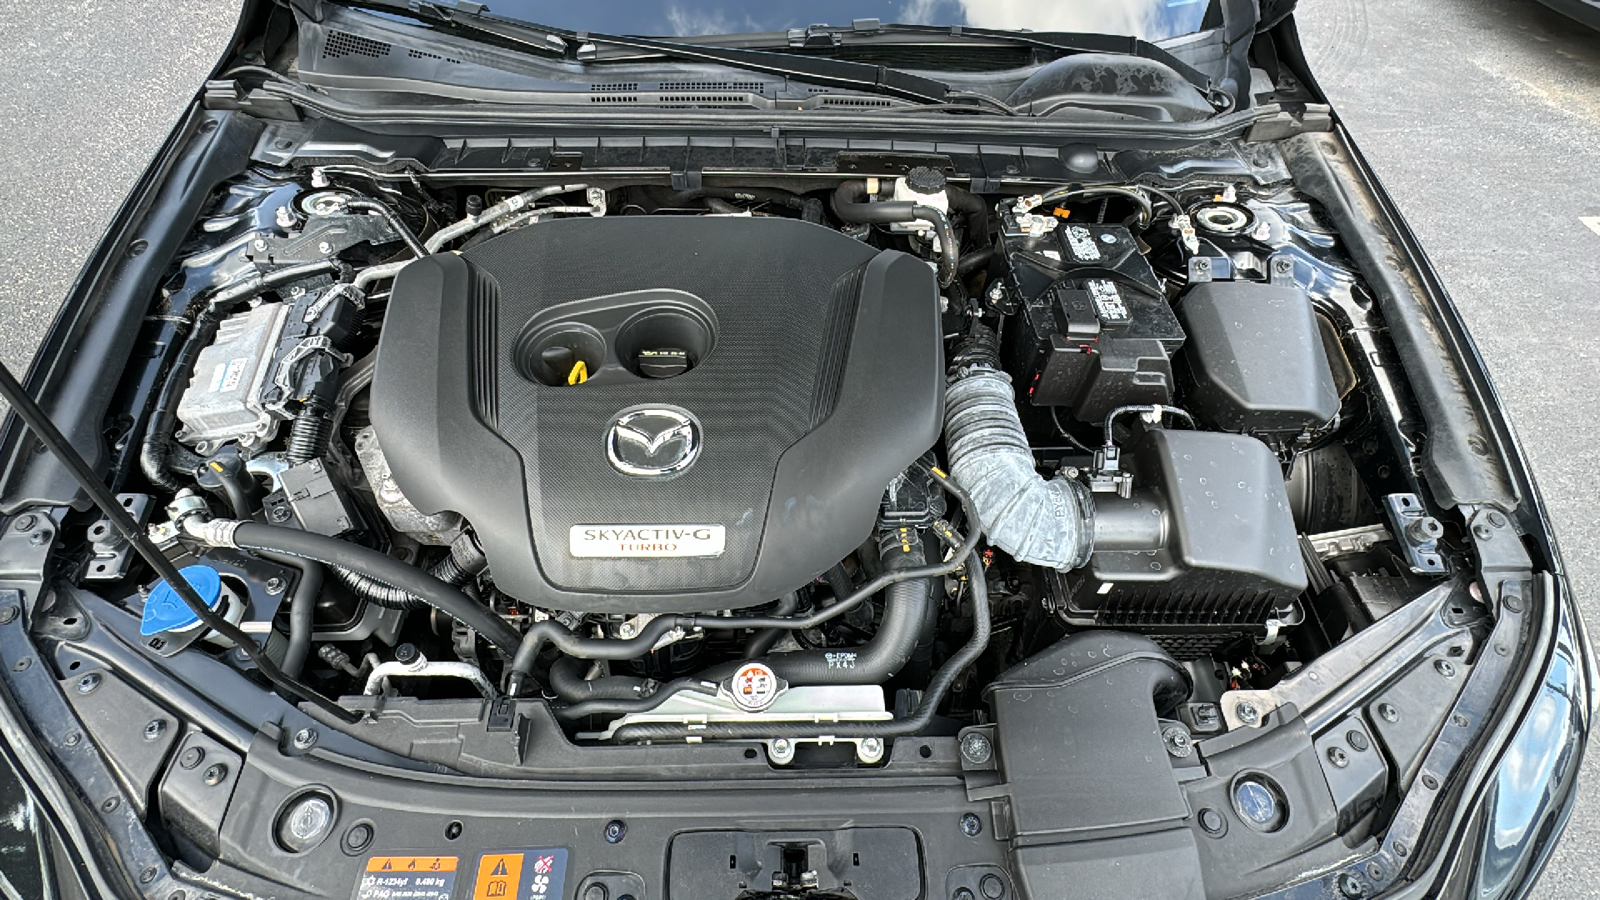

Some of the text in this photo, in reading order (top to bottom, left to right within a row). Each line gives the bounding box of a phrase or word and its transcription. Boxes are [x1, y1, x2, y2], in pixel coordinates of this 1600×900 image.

[584, 529, 711, 541] SKYACTIV-G
[618, 543, 677, 551] TURBO
[376, 877, 409, 887] R-1234yf
[435, 877, 445, 887] kg
[373, 889, 391, 899] PAG
